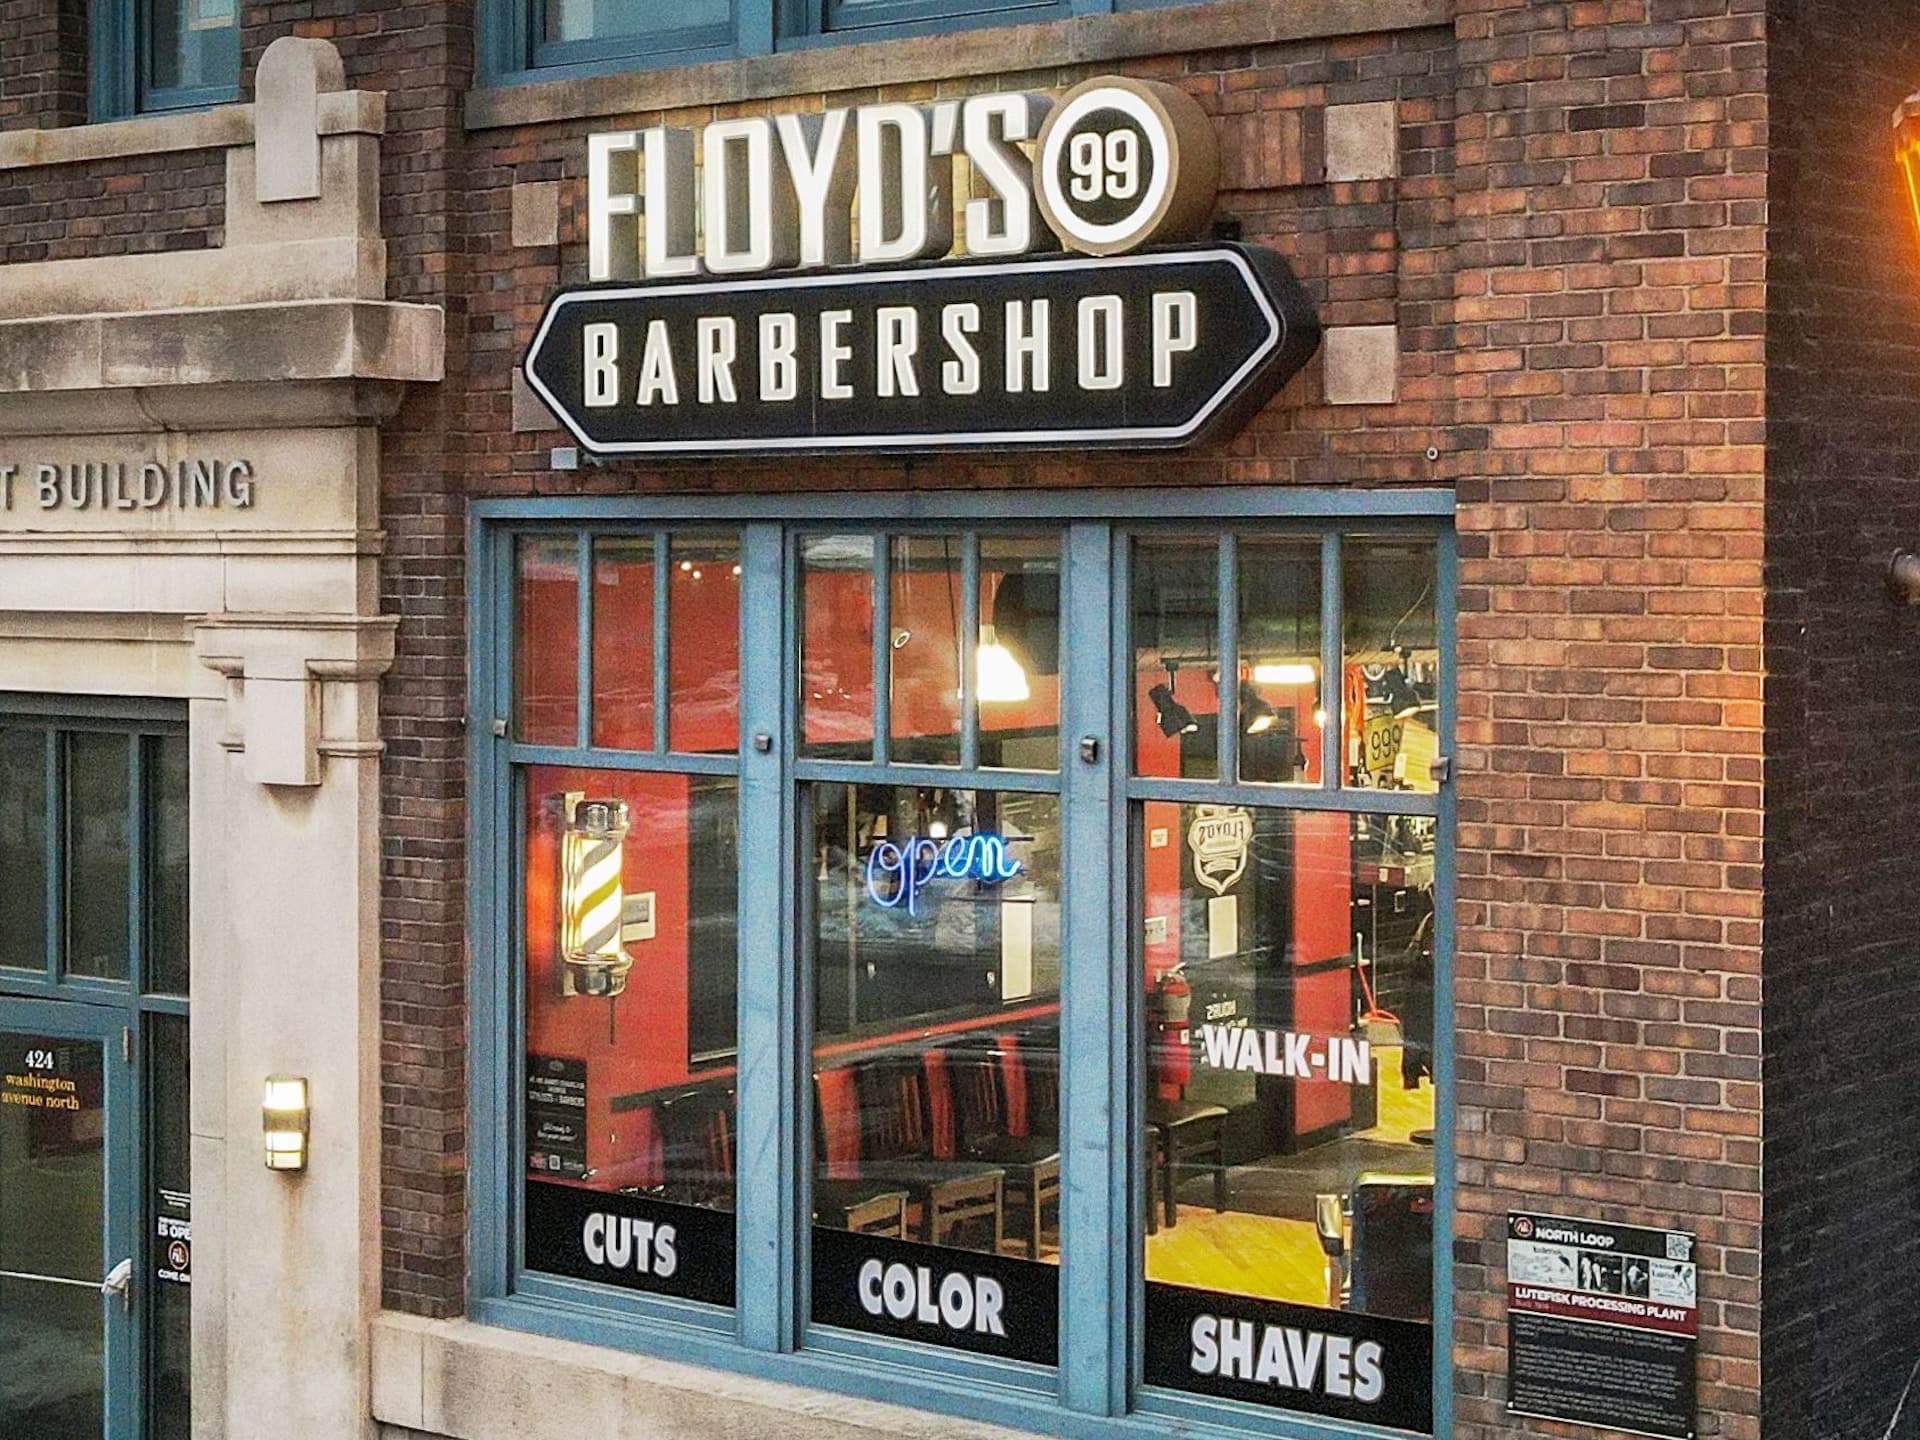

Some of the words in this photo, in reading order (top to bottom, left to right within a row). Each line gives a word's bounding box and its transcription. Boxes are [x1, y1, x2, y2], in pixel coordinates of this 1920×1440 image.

[587, 92, 1032, 282] FLOYD'S
[1069, 131, 1139, 202] 99
[582, 290, 1198, 408] BARBERSHOP
[36, 459, 255, 508] BUILDING
[867, 835, 1021, 916] open
[6, 1072, 76, 1093] washington
[25, 1049, 54, 1070] 424
[1201, 1024, 1370, 1085] WALK-IN
[1, 1092, 43, 1107] avenue
[46, 1095, 80, 1111] north
[582, 1212, 677, 1278] CUTS
[1535, 1227, 1578, 1244] NORTH
[1580, 1234, 1615, 1249] LOOP
[858, 1259, 1006, 1337] COLOR
[1515, 1287, 1571, 1306] LUTEFISK
[1571, 1295, 1646, 1316] PROCESSING
[1646, 1306, 1687, 1322] PLANT
[1190, 1313, 1384, 1400] SHAVES
